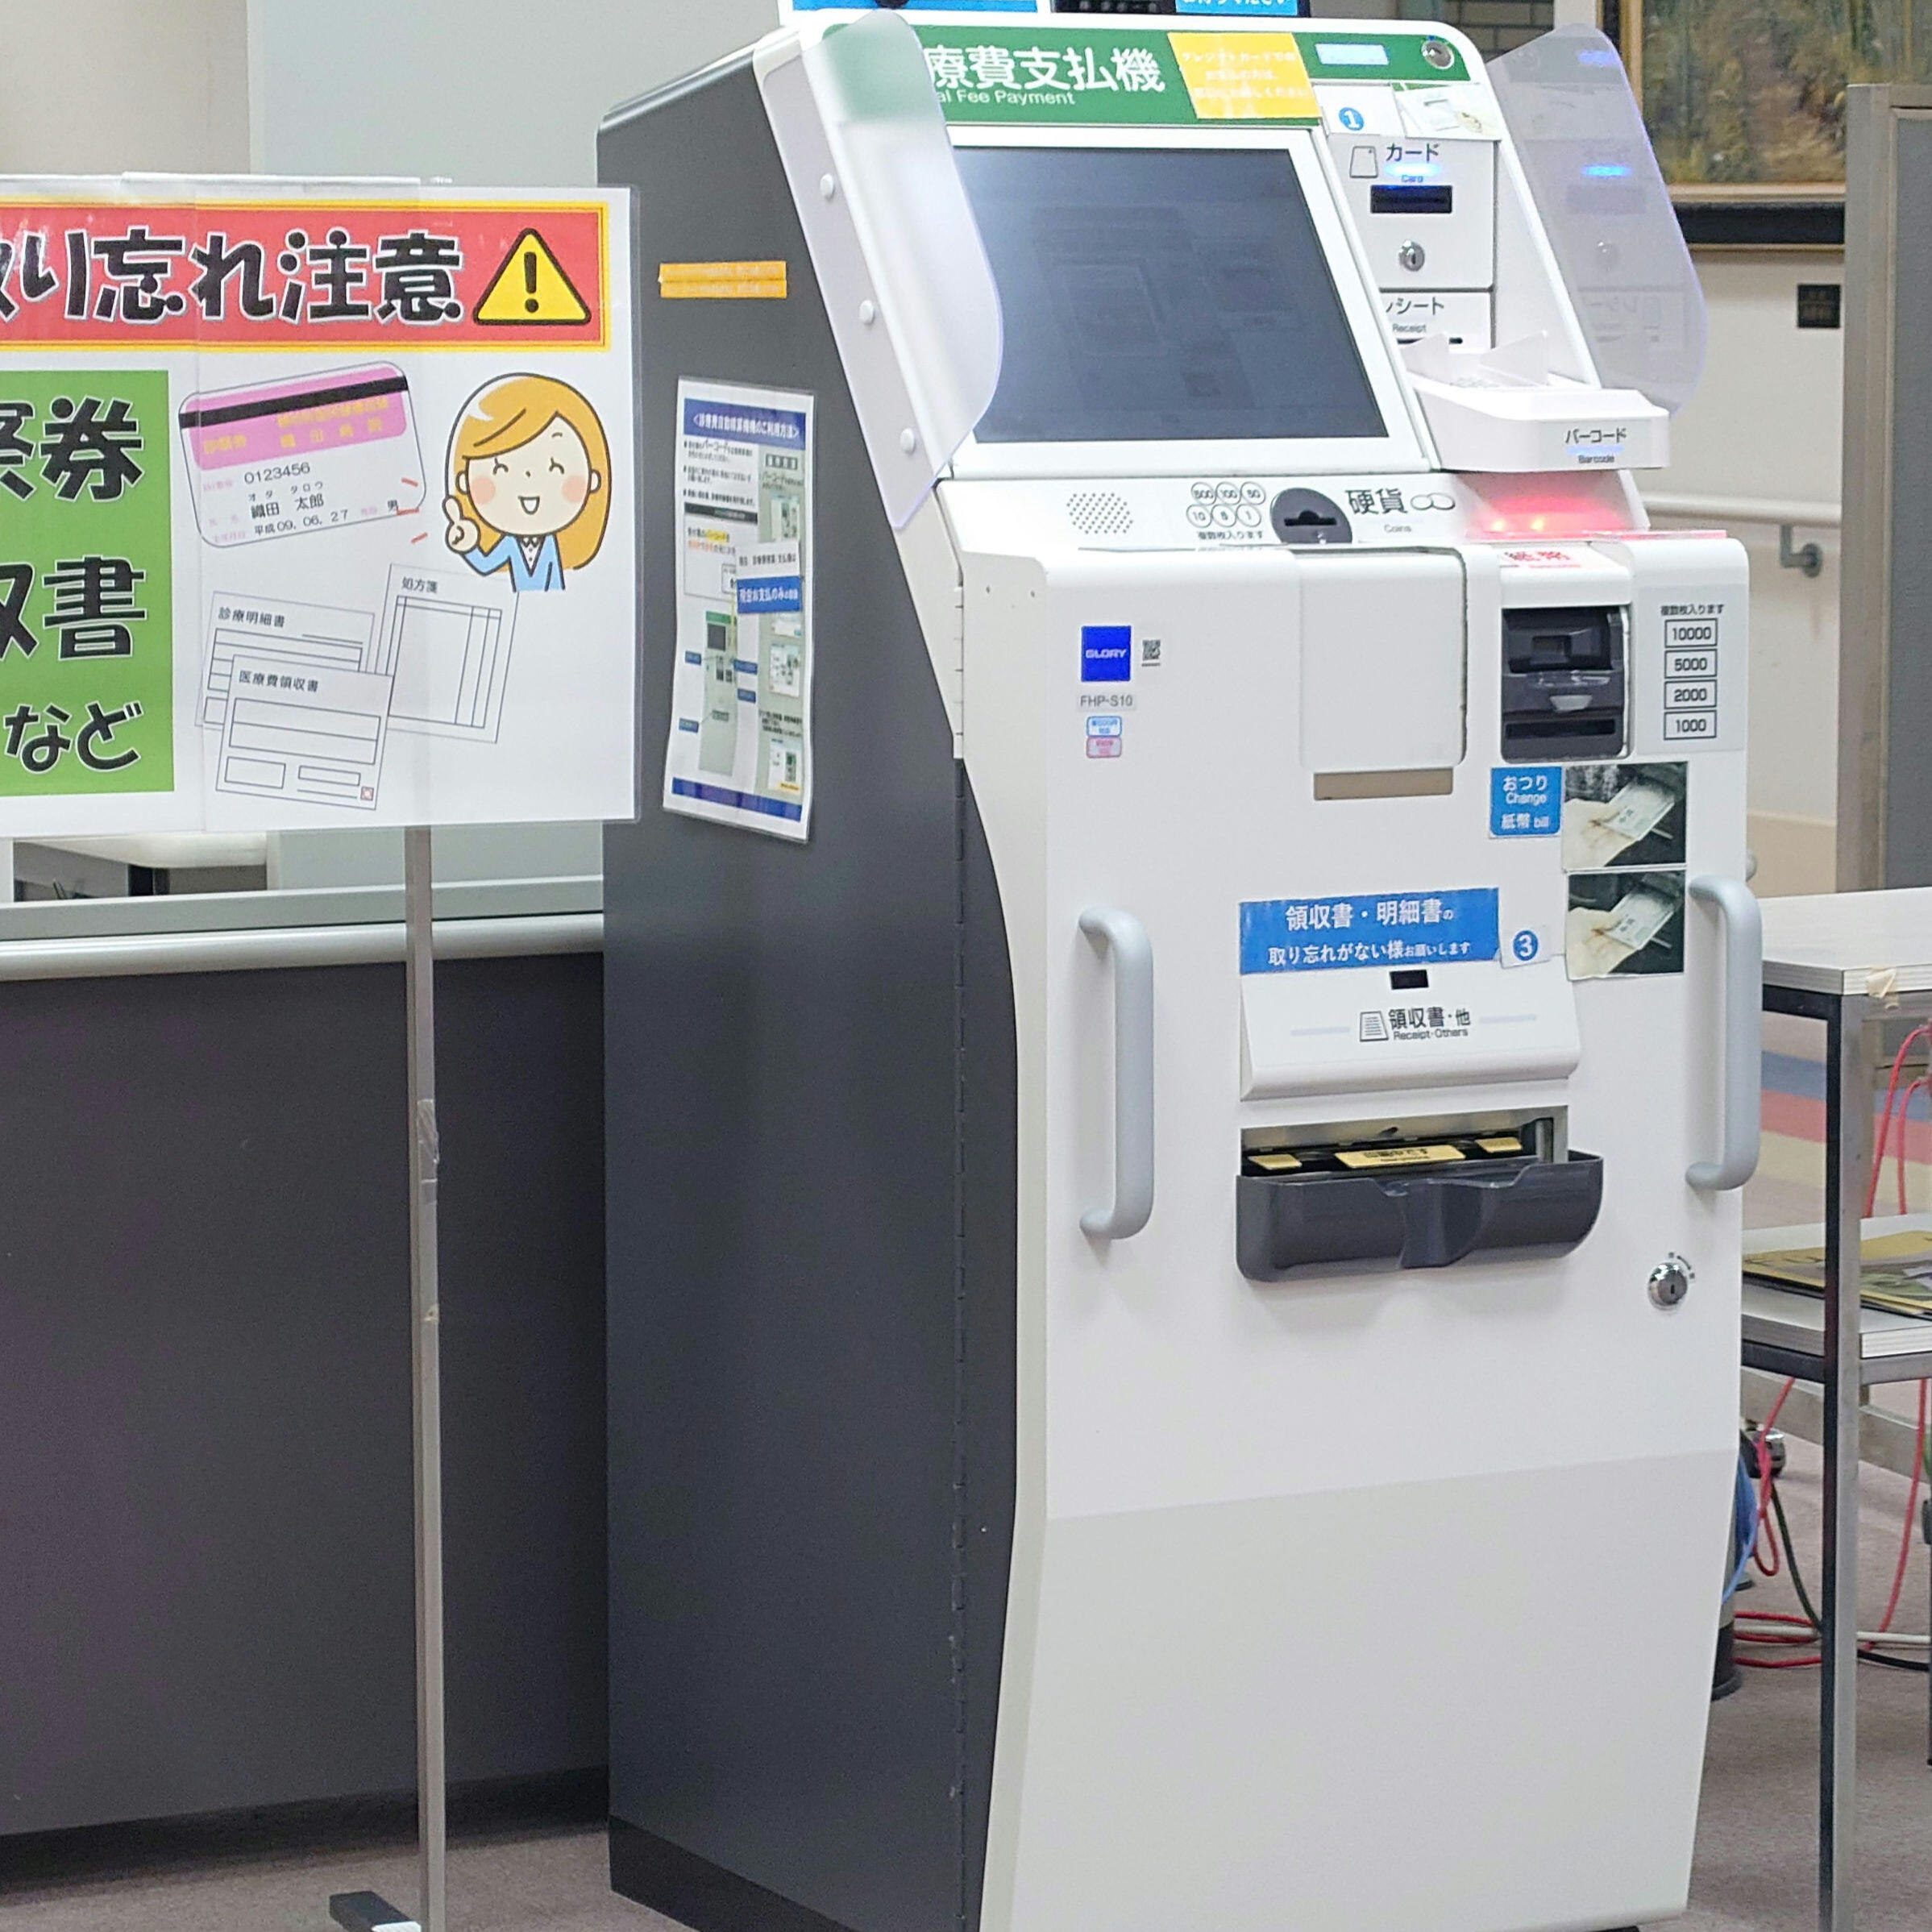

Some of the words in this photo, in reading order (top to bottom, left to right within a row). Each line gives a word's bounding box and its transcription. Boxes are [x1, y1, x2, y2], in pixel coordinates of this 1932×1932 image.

[957, 90, 991, 103] Fee
[995, 90, 1076, 106] Payment
[1386, 143, 1440, 163] カード
[0, 226, 464, 324] り忘れ注意
[1565, 428, 1627, 444] バーコード
[1578, 455, 1615, 464] Barcode
[243, 462, 310, 484] 0123456
[1219, 489, 1238, 499] 100
[1345, 488, 1407, 516] 硬貨
[251, 501, 280, 519] 織田
[294, 492, 324, 511] 太郎
[1192, 510, 1207, 521] 10
[218, 605, 286, 628] 診療明細書
[1671, 627, 1712, 640] 10000
[1085, 649, 1127, 659] GLORY
[1674, 658, 1708, 671] 5000
[239, 669, 319, 692] 医療費領収書
[1080, 695, 1133, 707] FHP-S10
[1673, 688, 1707, 702] 2000
[1675, 719, 1707, 732] 1000
[3, 700, 144, 774] など
[1502, 775, 1548, 792] おつり
[1506, 792, 1547, 806] Change
[1285, 897, 1456, 932] 領収書・明細書の
[1267, 940, 1471, 966] 取り忘れがない様お願いします
[1388, 1007, 1471, 1029] 領収書・他
